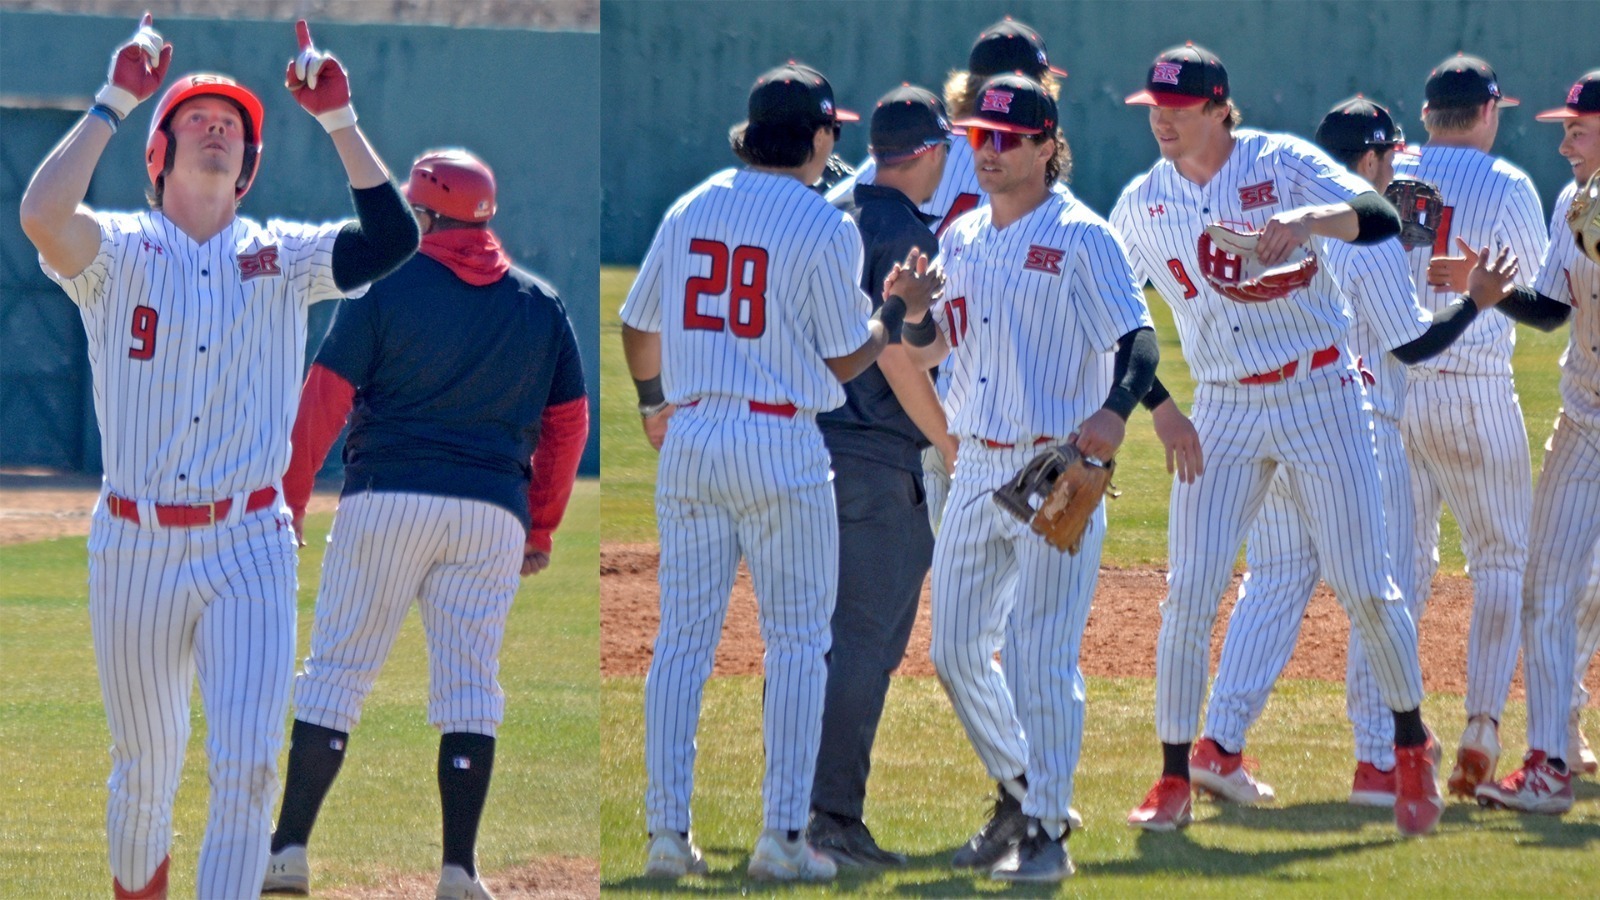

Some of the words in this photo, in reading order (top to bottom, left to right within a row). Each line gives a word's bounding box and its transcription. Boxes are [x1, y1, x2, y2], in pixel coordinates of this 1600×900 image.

[1152, 63, 1182, 84] SR
[981, 90, 1012, 112] SR
[1232, 181, 1278, 210] SR
[237, 247, 281, 281] SR
[1022, 246, 1064, 276] SR
[1167, 257, 1198, 299] 9
[682, 237, 767, 337] 28
[128, 305, 157, 360] 9
[943, 297, 967, 346] 17
